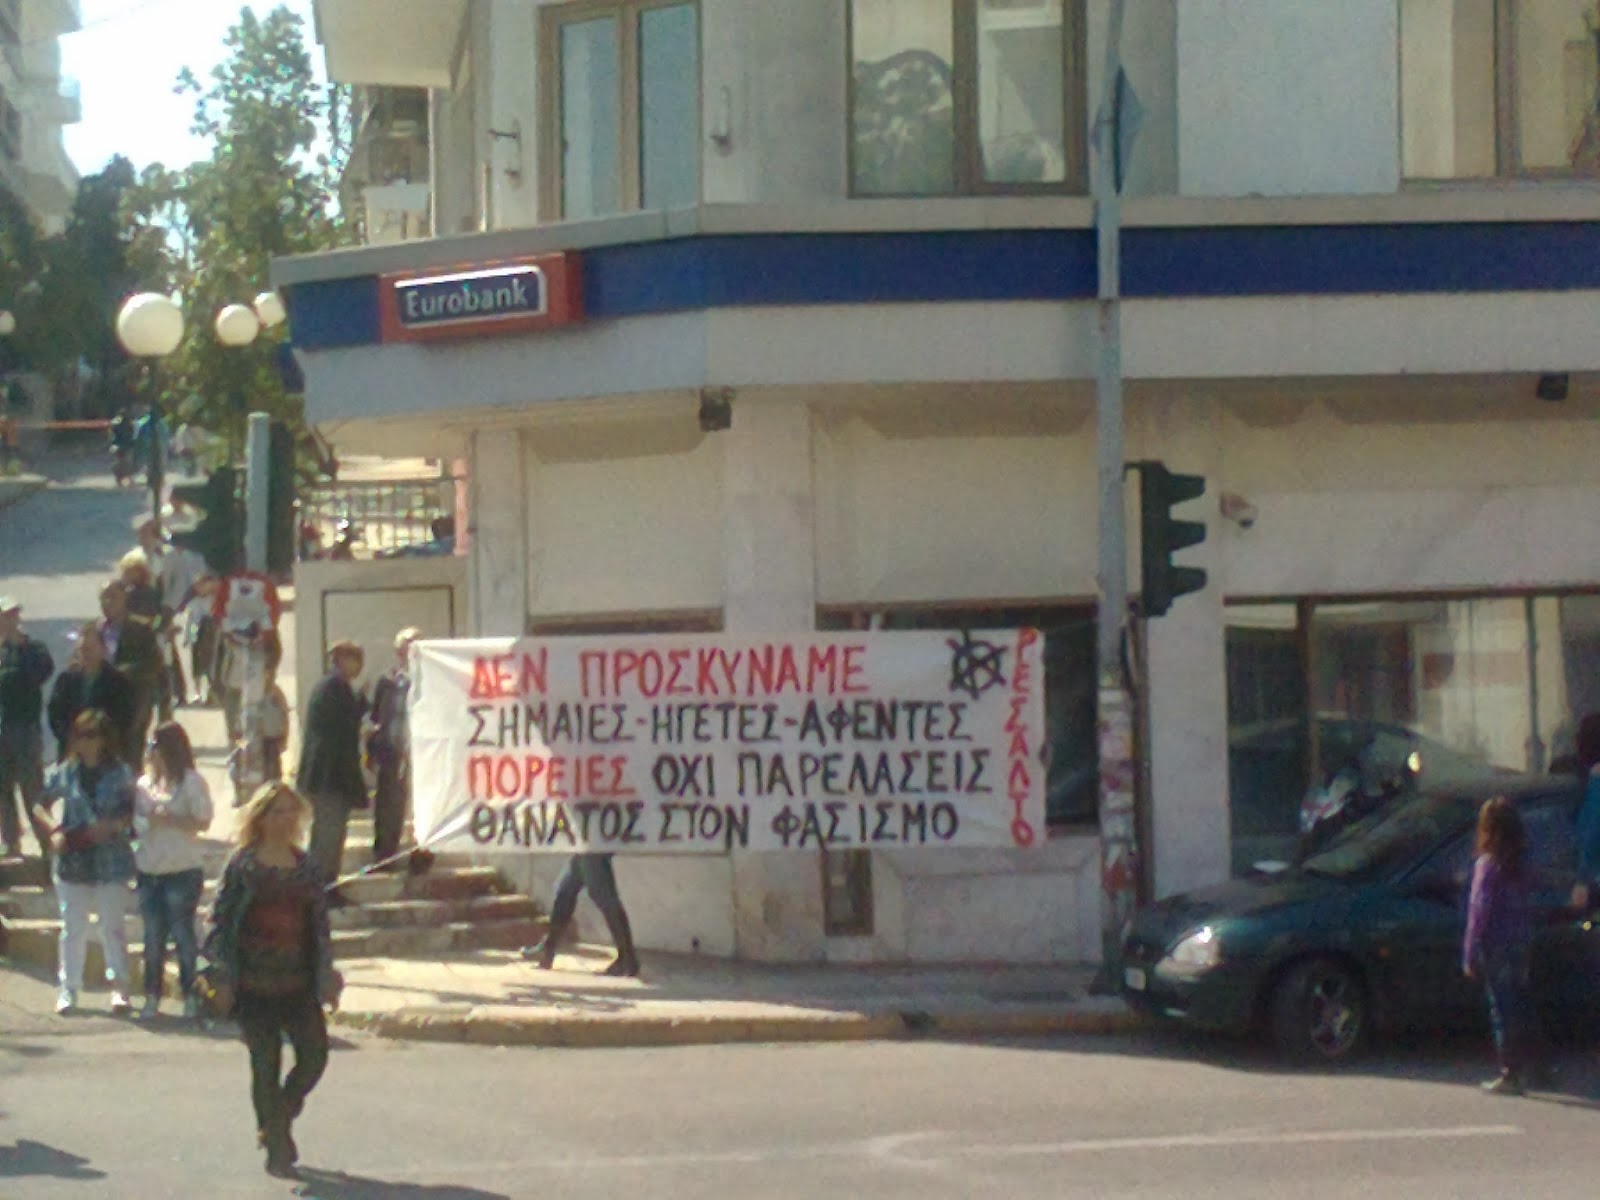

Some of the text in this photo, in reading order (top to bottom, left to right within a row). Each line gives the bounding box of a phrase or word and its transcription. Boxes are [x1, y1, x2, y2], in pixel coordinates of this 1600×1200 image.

[406, 278, 528, 318] Eurobank
[470, 645, 869, 699] ΔΕΝ ΠΡΟΣΚΥΝΑΜΕ
[468, 748, 993, 799] ΠΟΡΕΙΕΣ ΟΧΙ ΠΑΡΕΛΑΣΕΙΣ
[470, 800, 960, 852] ΘΑΝΑΤΟΣ ΣΤΟΝ ΦΑΣΙΣΜΟ
